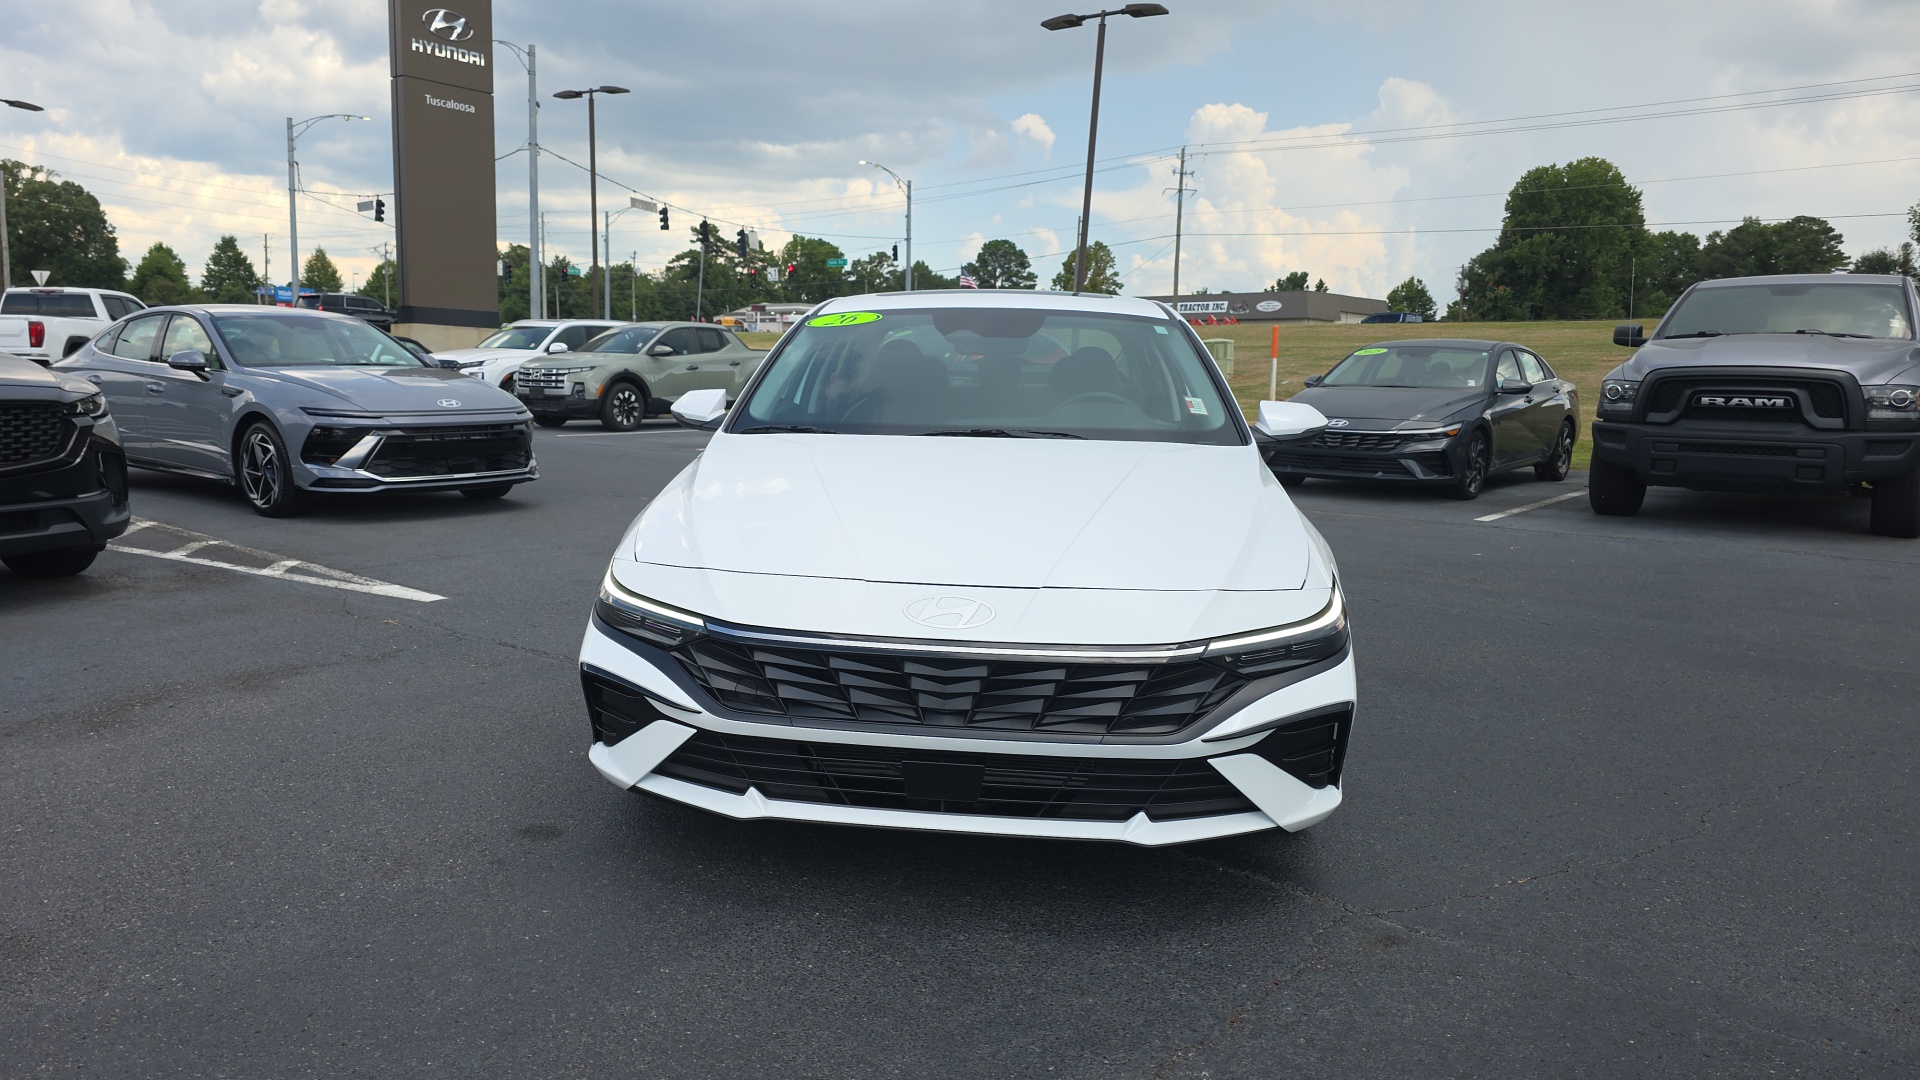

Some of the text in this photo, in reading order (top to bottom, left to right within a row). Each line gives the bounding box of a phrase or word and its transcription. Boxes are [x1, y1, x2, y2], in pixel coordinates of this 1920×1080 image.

[411, 37, 485, 67] HYUNDAI
[424, 93, 476, 114] Tuscaloosa
[1179, 303, 1210, 312] TRACTOR
[1211, 302, 1226, 311] INC.
[823, 313, 860, 325] 26
[1700, 396, 1785, 407] RAM
